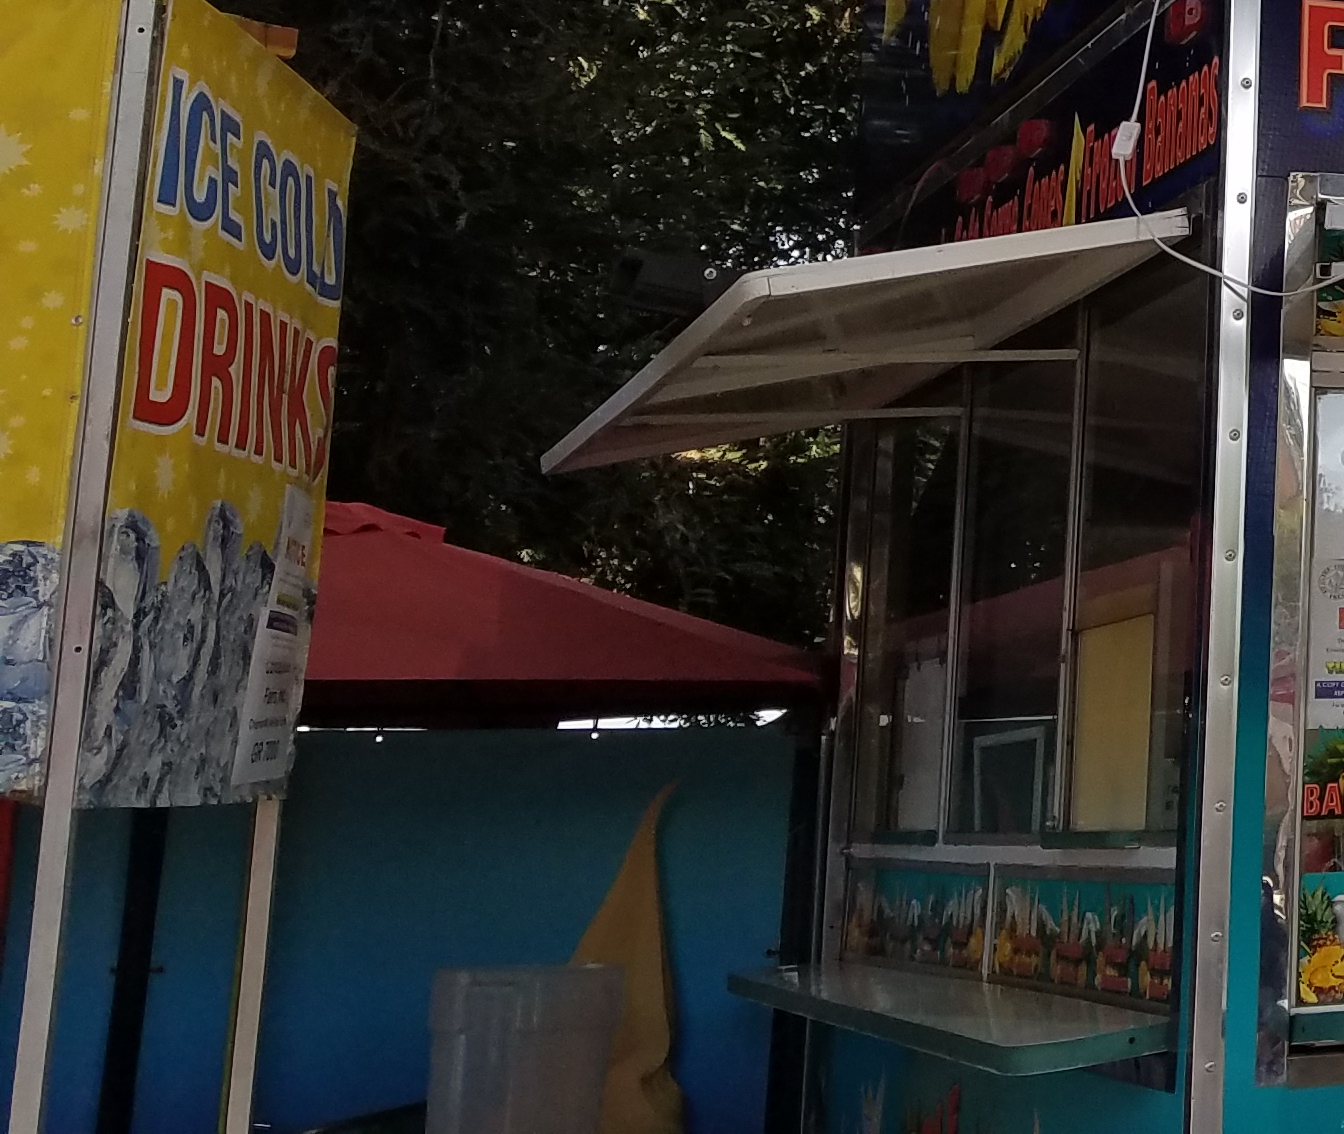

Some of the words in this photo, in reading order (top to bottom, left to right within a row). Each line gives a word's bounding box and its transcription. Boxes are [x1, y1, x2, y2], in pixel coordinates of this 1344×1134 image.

[155, 70, 243, 243] ICE
[254, 138, 345, 303] COLD
[1142, 55, 1219, 187] Bananas
[131, 258, 337, 482] DRINKS
